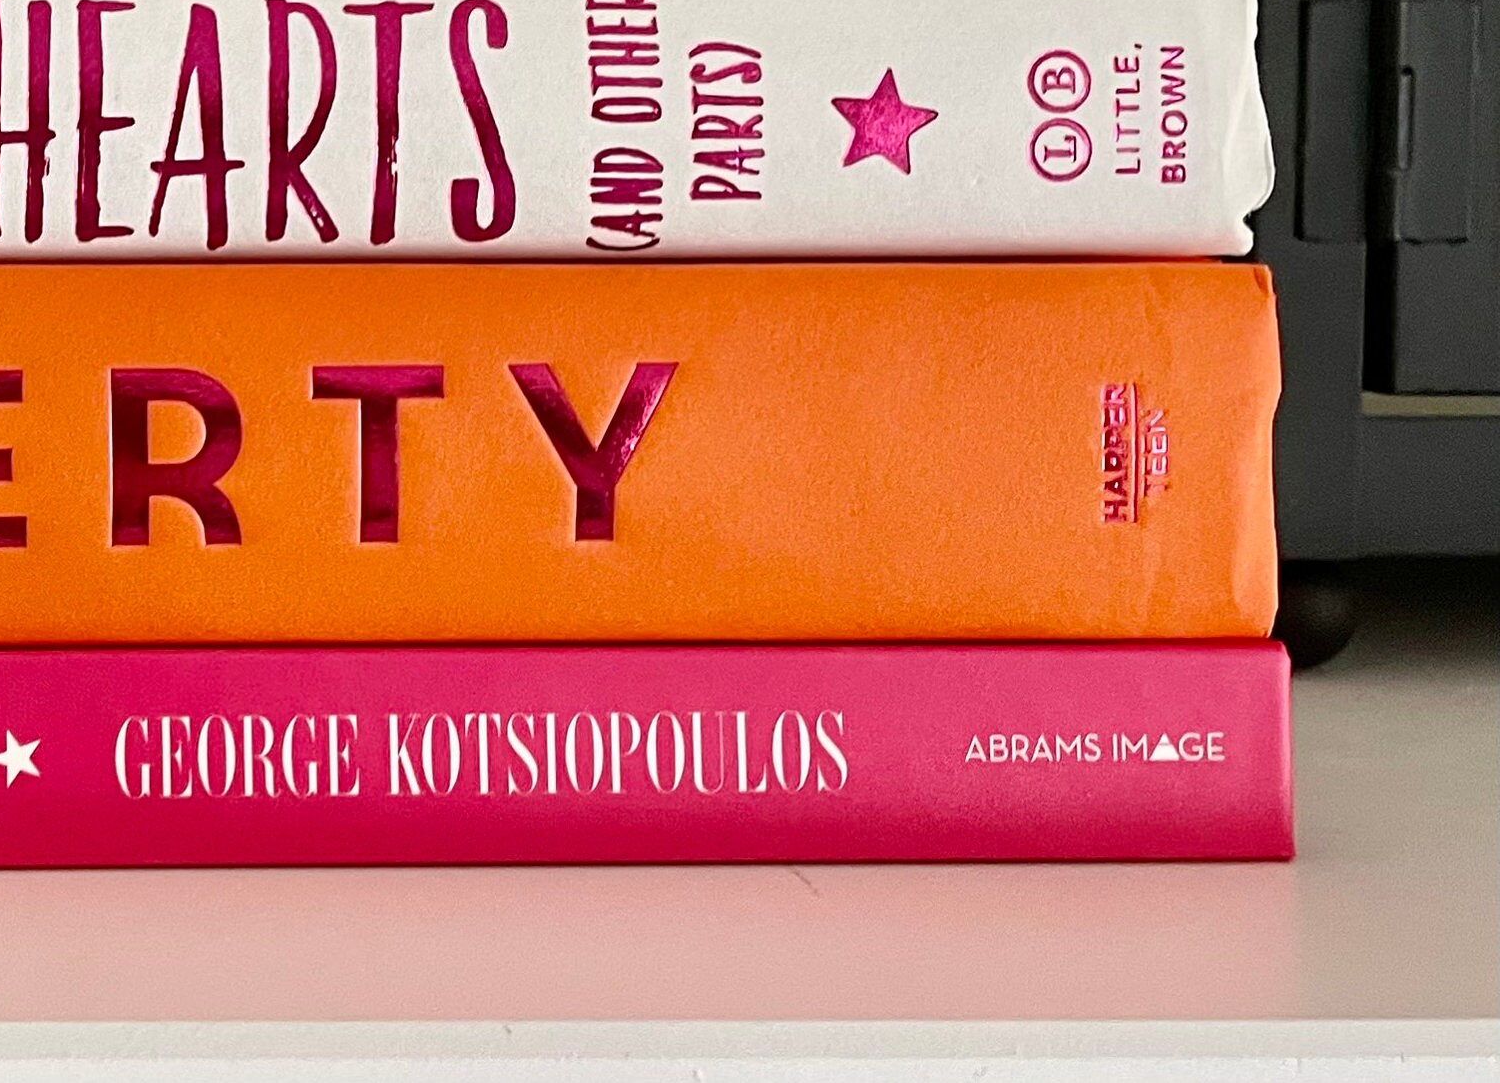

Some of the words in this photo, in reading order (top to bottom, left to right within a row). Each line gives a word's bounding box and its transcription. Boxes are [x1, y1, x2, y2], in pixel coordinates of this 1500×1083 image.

[688, 41, 766, 202] PARTS)
[1113, 43, 1143, 175] LITTLE,
[1160, 46, 1188, 184] BROWN
[585, 147, 664, 252] (AND
[1100, 382, 1130, 523] HARPER
[1142, 408, 1170, 499] TEEN
[114, 714, 361, 800] GEORGE
[387, 709, 850, 797] KOTSIOPOULOS
[964, 732, 1102, 763] ABRAMS
[1111, 731, 1226, 762] IMAGE
